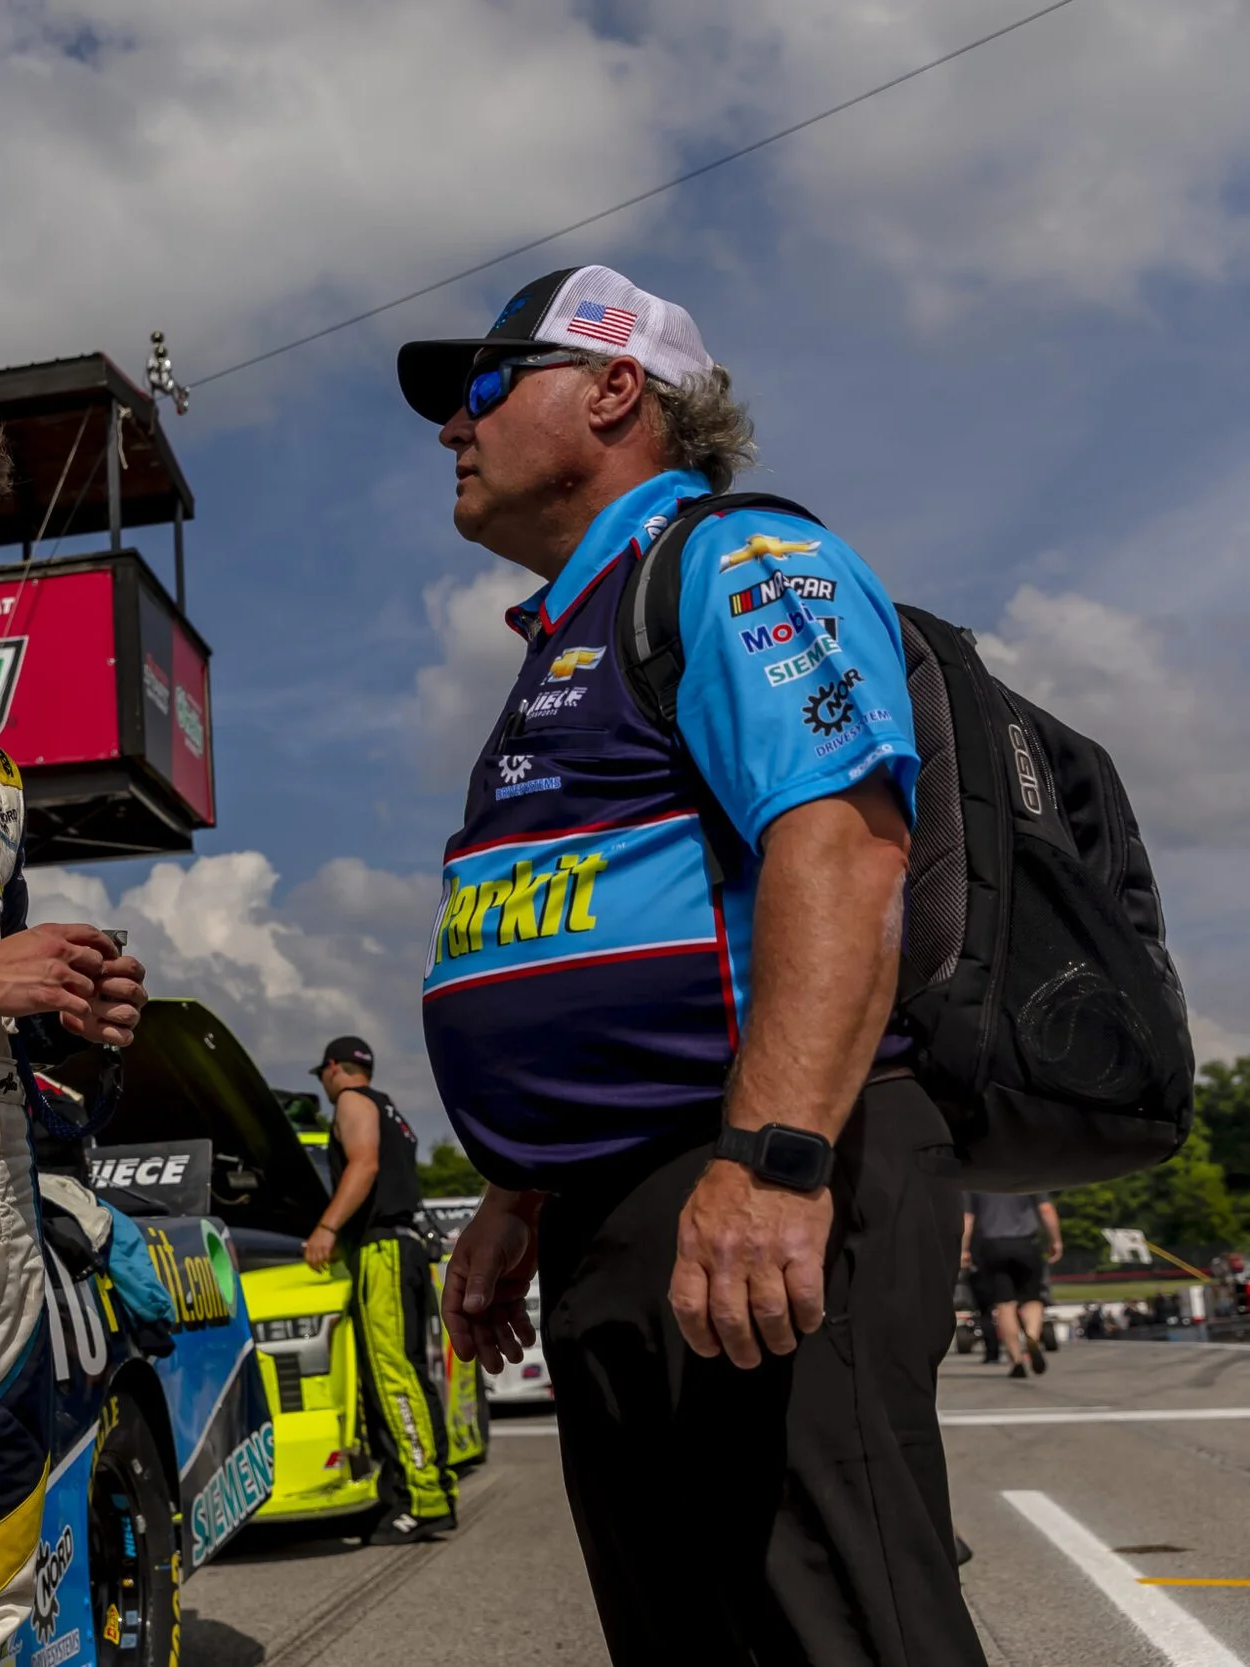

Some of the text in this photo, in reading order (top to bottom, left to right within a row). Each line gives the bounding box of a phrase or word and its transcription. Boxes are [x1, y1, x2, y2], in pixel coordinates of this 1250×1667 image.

[740, 603, 815, 654] Mobi
[768, 637, 839, 683] SIEME
[826, 668, 864, 718] NOR
[42, 1528, 73, 1609] NORD
